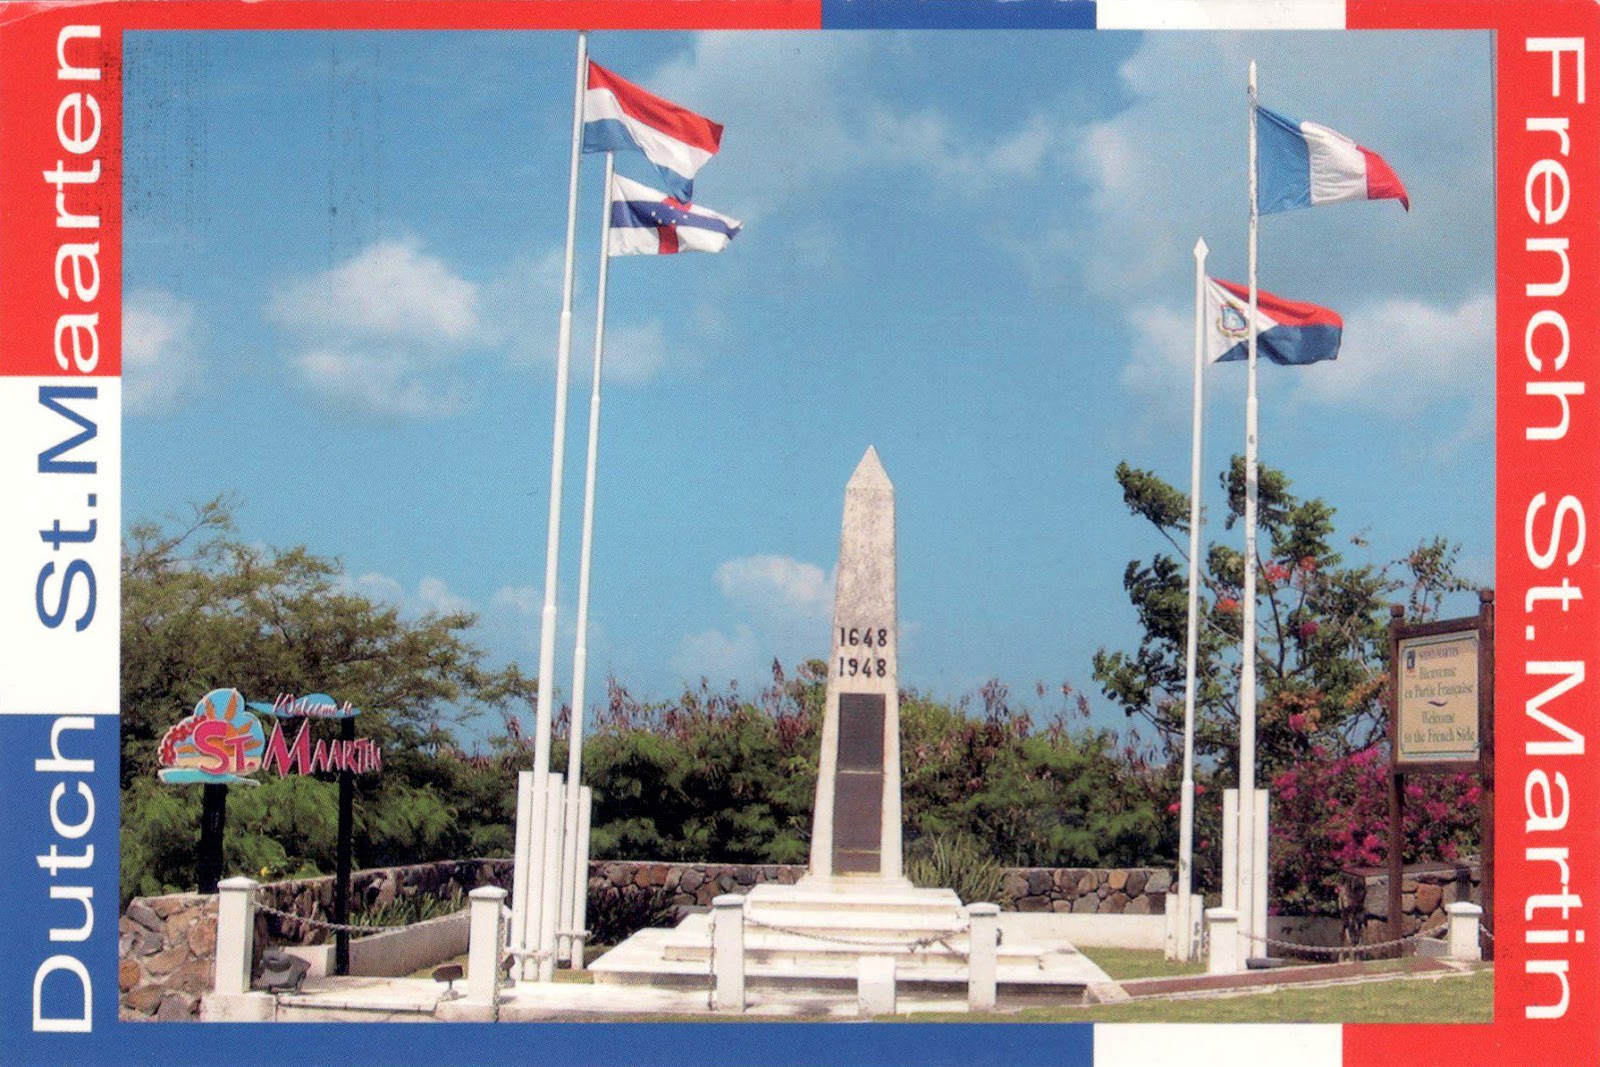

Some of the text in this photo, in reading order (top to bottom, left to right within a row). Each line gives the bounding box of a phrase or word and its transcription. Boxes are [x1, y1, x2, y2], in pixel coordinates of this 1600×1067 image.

[840, 627, 887, 648] 1648
[839, 656, 887, 678] 1948
[1421, 711, 1455, 724] Welcome
[1404, 727, 1475, 743] to the French Side
